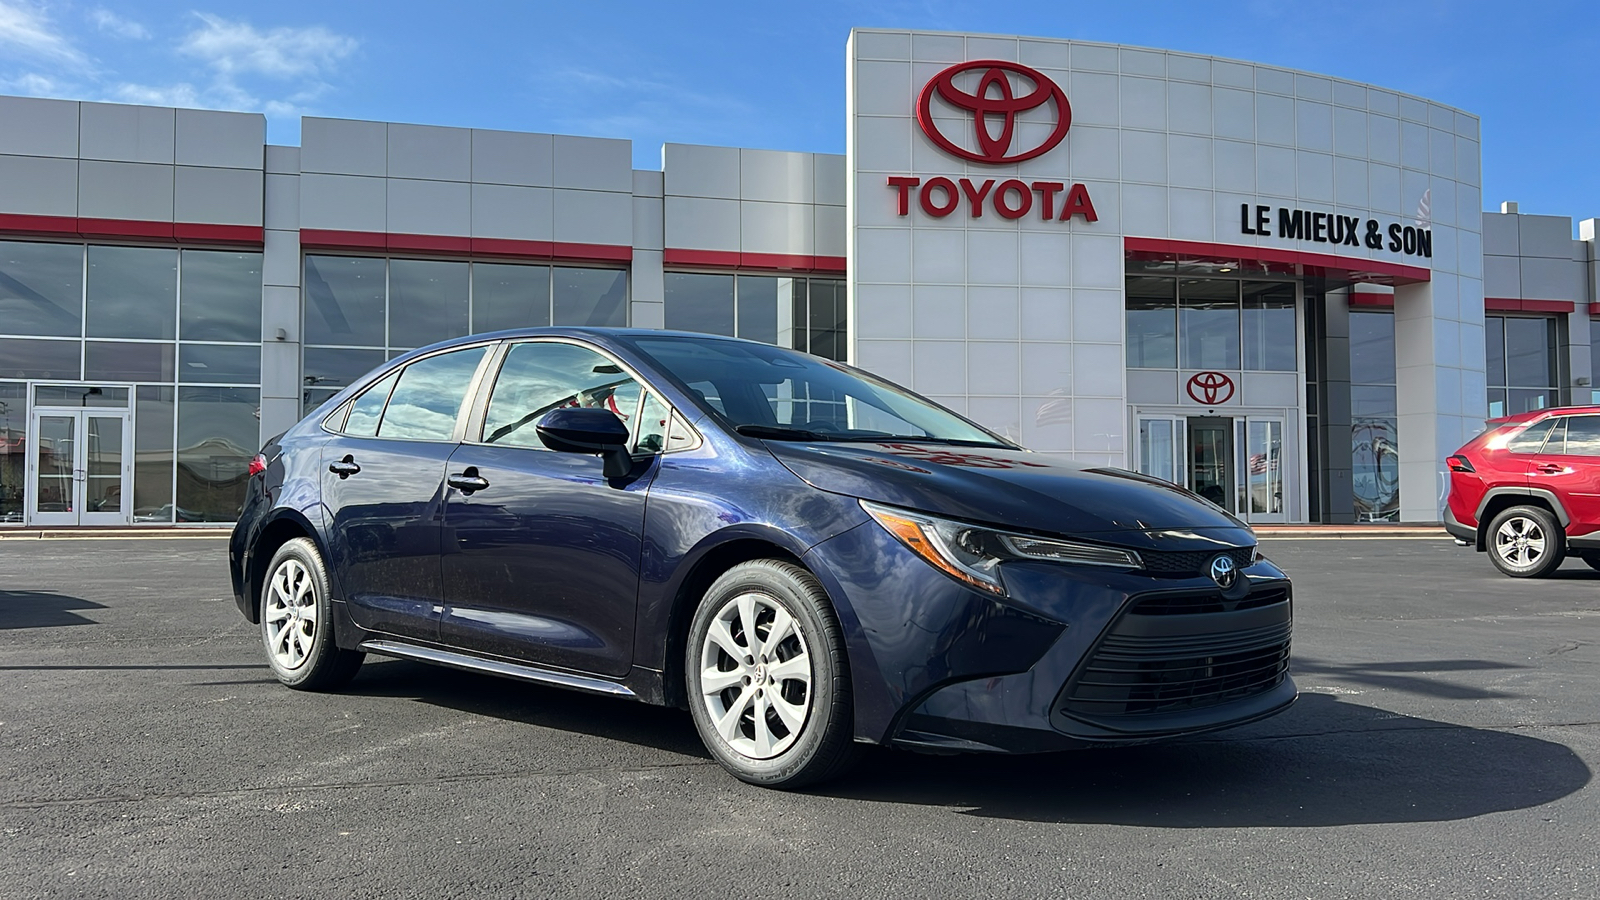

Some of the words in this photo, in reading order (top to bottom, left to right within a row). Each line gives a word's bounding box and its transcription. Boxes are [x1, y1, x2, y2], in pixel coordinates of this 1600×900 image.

[887, 176, 1098, 222] TOYOTA
[1241, 203, 1271, 236] LE
[1279, 207, 1360, 246] MIEUX
[1365, 219, 1383, 250] &
[1388, 222, 1432, 258] SON
